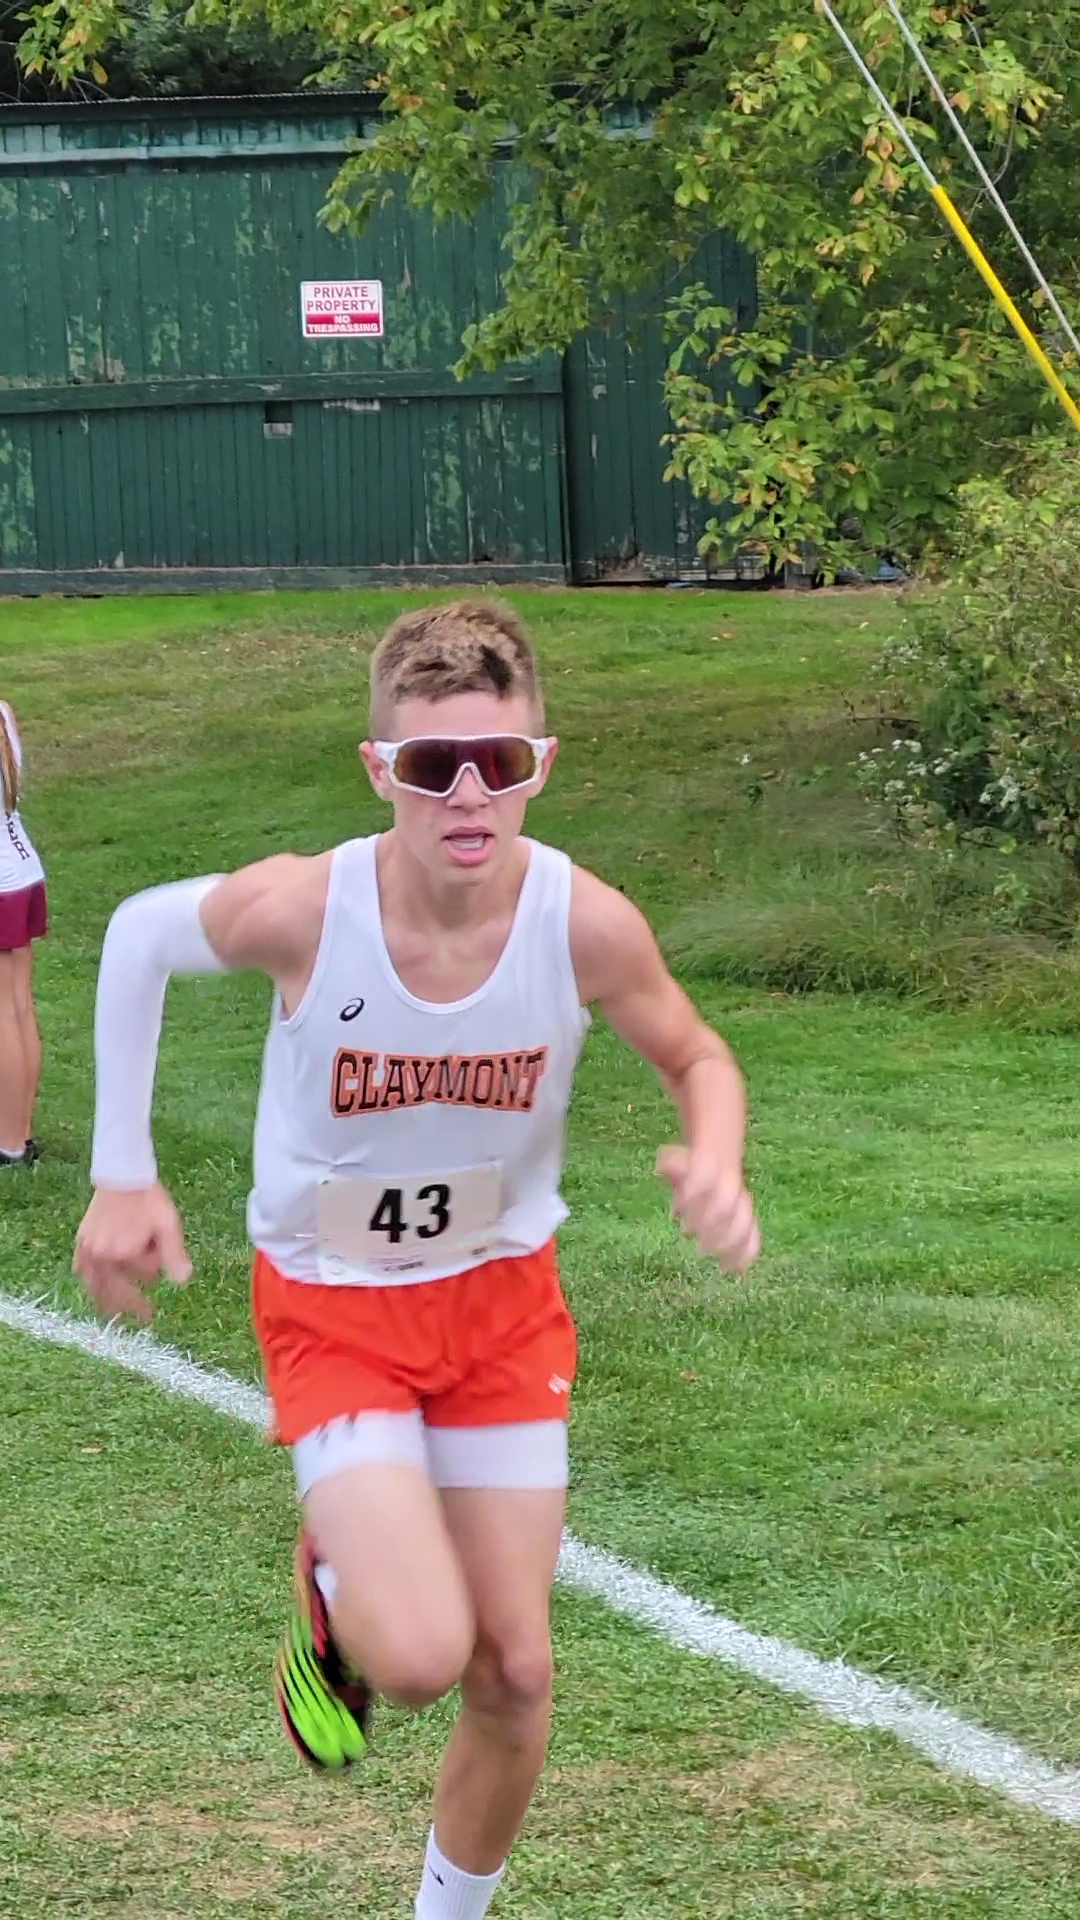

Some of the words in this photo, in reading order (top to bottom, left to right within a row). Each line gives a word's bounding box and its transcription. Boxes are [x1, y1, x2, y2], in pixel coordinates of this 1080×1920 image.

[314, 286, 369, 298] PRIVATE
[307, 299, 376, 311] PROPERTY
[334, 315, 351, 323] NO
[307, 323, 379, 333] TRESPASSING
[331, 1046, 548, 1118] CLAYMONT
[368, 1183, 452, 1244] 43
